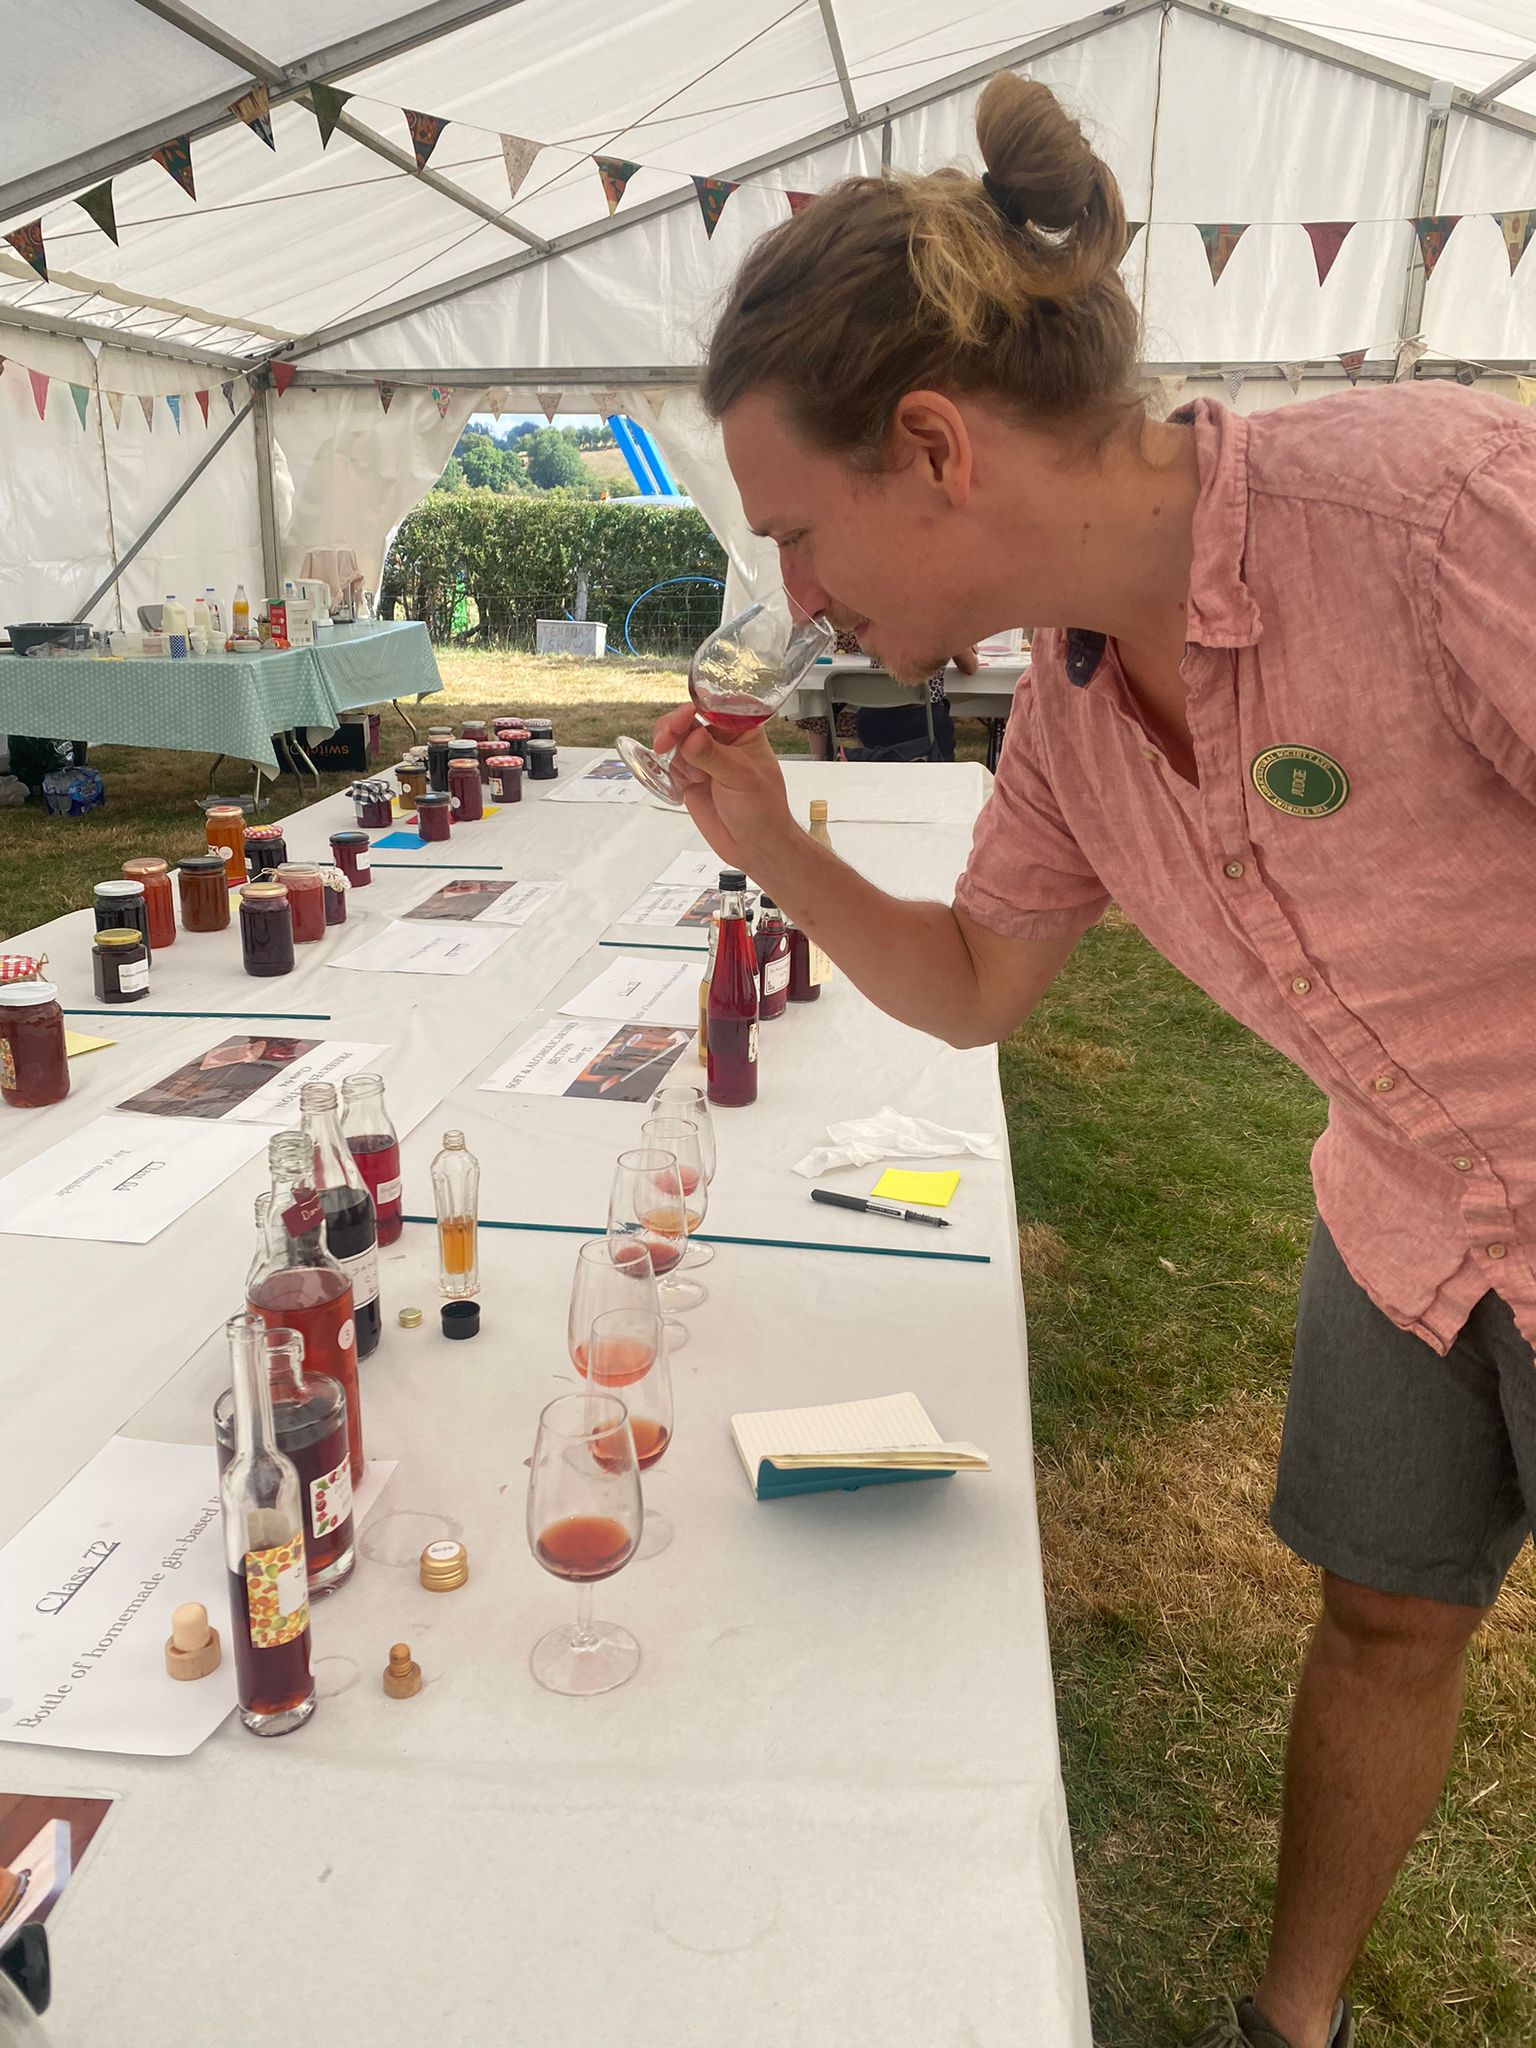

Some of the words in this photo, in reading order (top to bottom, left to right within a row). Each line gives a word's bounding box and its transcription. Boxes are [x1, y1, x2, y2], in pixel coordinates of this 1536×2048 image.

[1291, 768, 1307, 798] JUDGE
[308, 1052, 353, 1081] PRESERVES
[506, 1074, 527, 1089] SOFT
[54, 1164, 105, 1197] marmalade
[132, 1161, 166, 1181] Class
[161, 1507, 220, 1570] gin-based
[36, 1566, 95, 1613] Class
[82, 1540, 120, 1558] 72
[81, 1572, 165, 1659] homemade
[71, 1661, 94, 1679] of
[15, 1684, 73, 1728] Bottle
